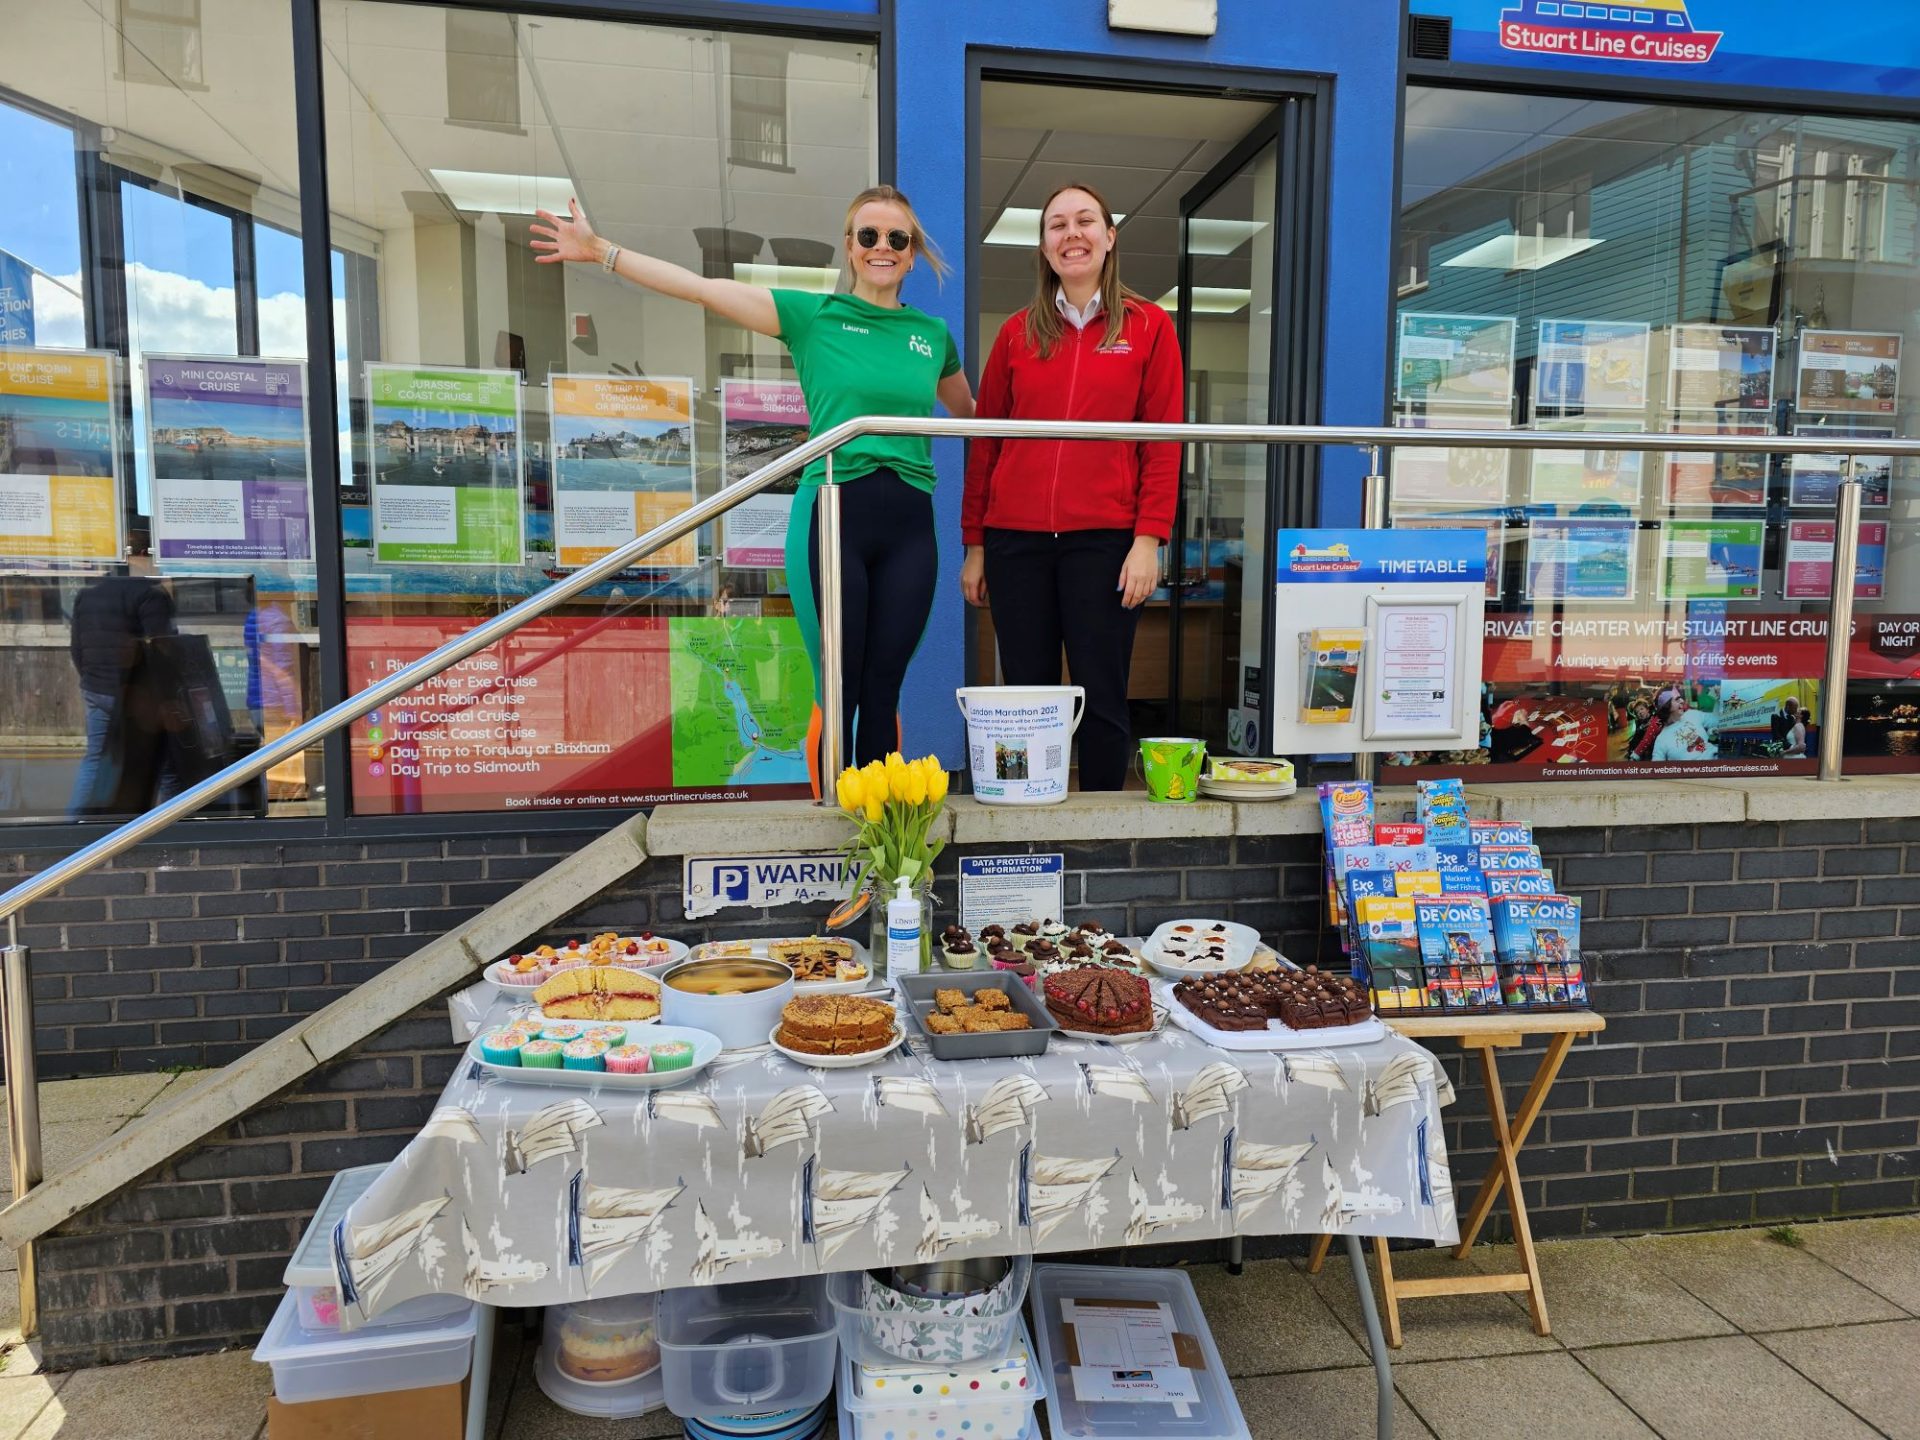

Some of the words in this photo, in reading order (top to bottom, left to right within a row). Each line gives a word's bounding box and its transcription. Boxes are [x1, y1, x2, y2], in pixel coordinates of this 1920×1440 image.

[1506, 24, 1577, 49] Stuart
[1582, 31, 1626, 53] Line
[1630, 34, 1707, 60] Cruises
[842, 322, 869, 335] Lauren
[34, 363, 72, 374] ROBIN
[10, 375, 55, 385] CRUISE
[181, 370, 205, 380] MINI
[206, 371, 258, 382] COASTAL
[199, 381, 241, 392] CRUISE
[410, 380, 462, 390] JURASSIC
[594, 384, 613, 393] DAY
[615, 385, 633, 393] TRIP
[635, 385, 647, 393] TO
[398, 391, 433, 400] COAST
[436, 392, 473, 401] CRUISE
[600, 393, 645, 402] TORQUAY
[760, 393, 777, 403] DAY
[779, 394, 800, 404] TRIP
[611, 403, 648, 412] BRIXHAM
[341, 491, 369, 501] acer
[1292, 563, 1315, 571] Stuart
[1316, 563, 1331, 571] Line
[1332, 563, 1358, 571] Cruises
[1378, 560, 1468, 573] TIMETABLE
[1483, 620, 1546, 637] RIVATE
[1550, 620, 1630, 637] CHARTER
[1634, 620, 1678, 637] WITH
[1682, 620, 1748, 637] STUART
[1751, 620, 1786, 637] LINE
[1789, 620, 1857, 637] CRUIS
[1878, 622, 1901, 634] DAY
[1903, 622, 1920, 634] OR
[1881, 635, 1916, 647] NIGHT
[370, 661, 375, 669] 1
[386, 659, 413, 672] Riv
[455, 658, 498, 671] Cruise
[1554, 654, 1565, 666] A
[1567, 655, 1609, 669] unique
[1612, 655, 1650, 666] venue
[1653, 654, 1672, 666] for
[1674, 654, 1689, 666] all
[1692, 654, 1705, 666] of
[1708, 653, 1735, 666] life's
[1739, 654, 1778, 666] events
[427, 676, 464, 688] River
[467, 676, 492, 688] Exe
[495, 675, 538, 687] Cruise
[388, 694, 435, 707] Round
[441, 693, 480, 705] Robin
[482, 692, 525, 704] Cruise
[371, 713, 378, 722] 3
[389, 711, 417, 724] Mini
[420, 710, 474, 723] Coastal
[477, 709, 520, 722] Cruise
[970, 707, 994, 717] London
[995, 708, 1039, 717] Marathon
[1040, 705, 1059, 715] 2023
[372, 731, 379, 739] 4
[389, 728, 447, 741] Jurassic
[450, 727, 491, 740] Coast
[494, 727, 537, 738] Cruise
[372, 749, 379, 757] 5
[391, 746, 420, 761] Day
[424, 745, 451, 759] Trip
[455, 746, 470, 757] to
[474, 744, 533, 759] Torquay
[537, 745, 551, 755] or
[555, 742, 611, 754] Brixham
[373, 766, 380, 774] 6
[391, 763, 421, 778] Day
[424, 762, 451, 776] Trip
[455, 763, 471, 774] to
[474, 759, 540, 774] Sidmouth
[1542, 768, 1556, 776] For
[1578, 768, 1622, 776] information
[1623, 767, 1638, 775] visit
[1654, 766, 1681, 775] website
[1682, 764, 1779, 774] www.stuartlinecruises.co.uk
[505, 798, 531, 807] Book
[533, 797, 562, 806] inside
[577, 796, 607, 805] online
[621, 790, 749, 803] www.stuartlinecruises.co.uk
[1337, 828, 1368, 840] rides
[1381, 826, 1401, 835] BOAT
[1402, 827, 1423, 835] TRIPS
[1472, 828, 1529, 845] DEVON'S
[972, 859, 995, 867] DATA
[996, 857, 1052, 866] PROTECTION
[1346, 854, 1370, 869] Exe
[1436, 852, 1458, 866] Exe
[1480, 853, 1539, 871] DEVON'S
[982, 865, 1042, 874] INFORMATION
[1389, 859, 1413, 873] Exe
[719, 868, 743, 896] P
[1352, 879, 1375, 892] Exe
[1446, 883, 1459, 891] Reef
[1460, 883, 1481, 892] Fishing
[1492, 877, 1551, 894] DEVON'S
[1420, 906, 1482, 923] DEVON'S
[1509, 903, 1576, 920] DEVON'S
[1526, 918, 1575, 926] ATTRACTIONS
